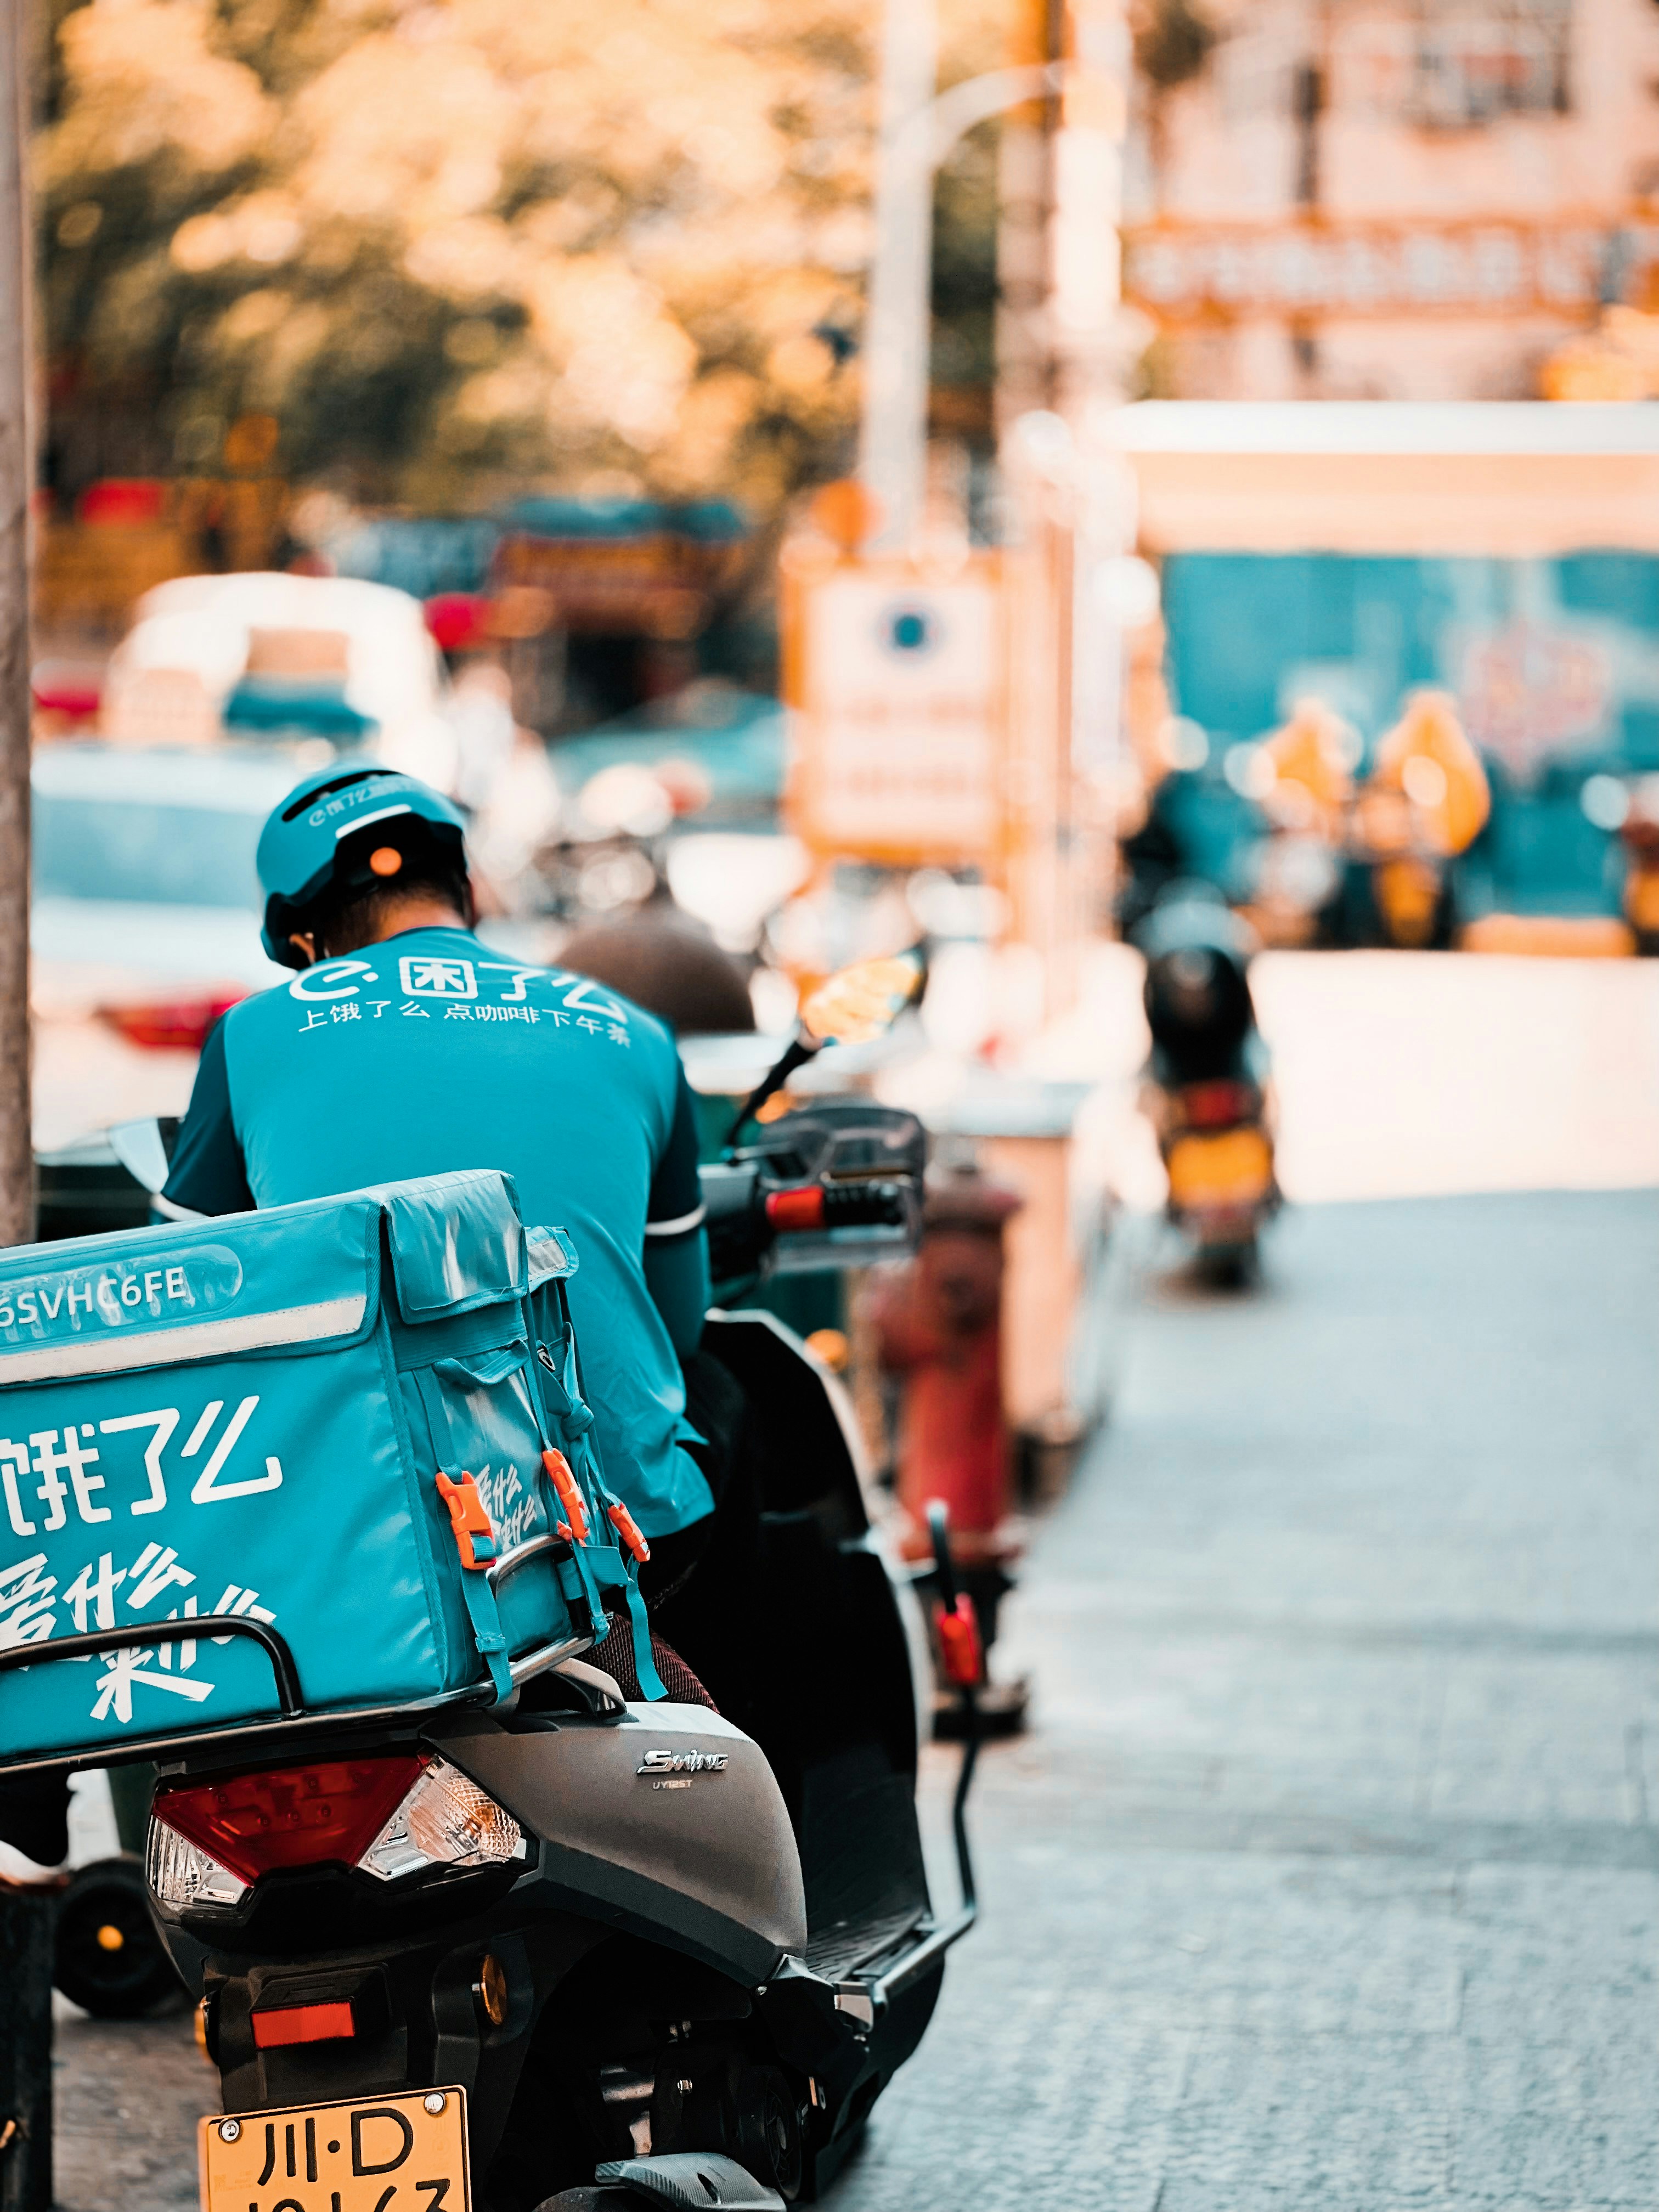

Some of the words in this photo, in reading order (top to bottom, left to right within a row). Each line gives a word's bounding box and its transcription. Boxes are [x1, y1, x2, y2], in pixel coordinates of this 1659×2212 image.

[398, 956, 629, 1025] 困了么
[298, 999, 431, 1032] 上饿了么
[443, 1003, 632, 1048] 点咖啡下午茶
